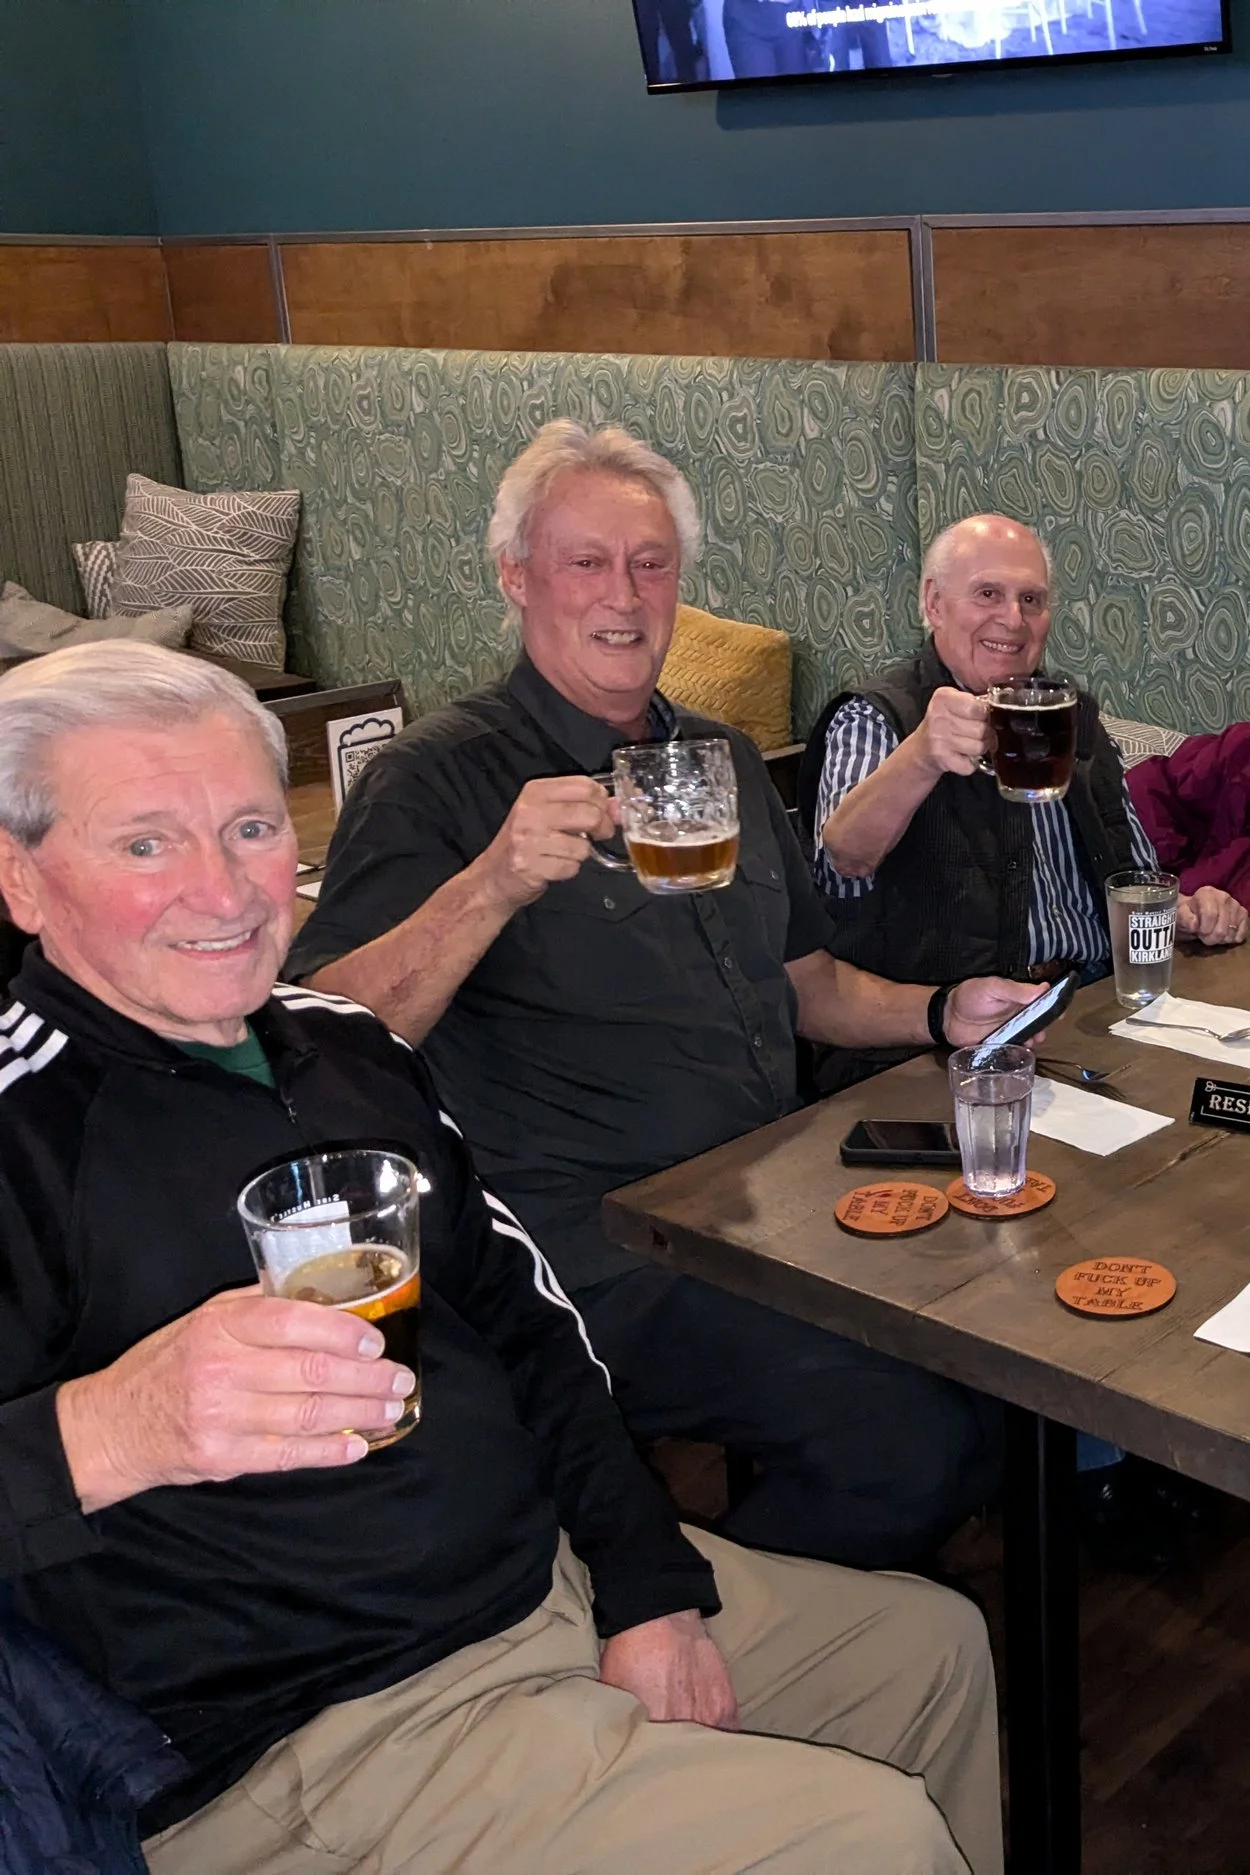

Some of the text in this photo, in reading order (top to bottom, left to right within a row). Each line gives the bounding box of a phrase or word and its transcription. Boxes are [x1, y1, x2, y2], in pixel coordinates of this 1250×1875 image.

[1131, 912, 1176, 928] STRAIGHT
[1092, 1261, 1152, 1274] DON'T
[1073, 1271, 1162, 1287] FUCK UP
[1094, 1286, 1132, 1297] MY
[1072, 1295, 1144, 1310] TABLE
